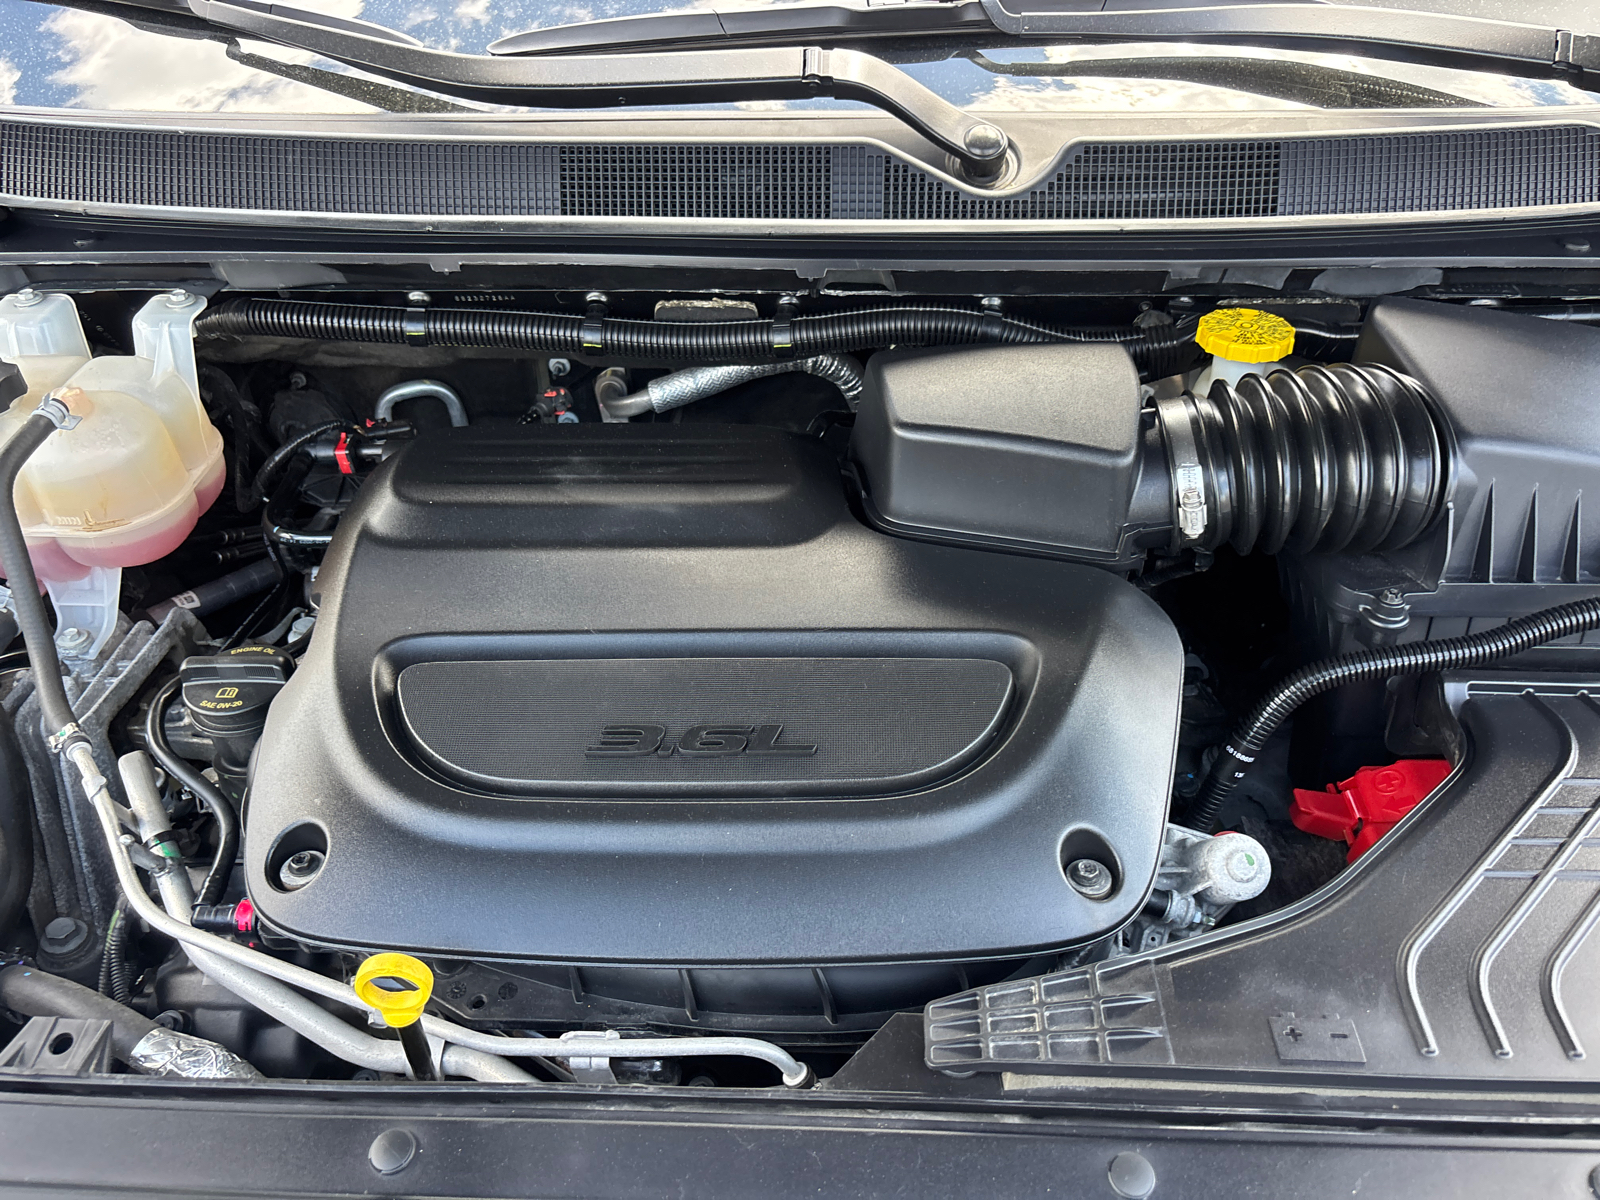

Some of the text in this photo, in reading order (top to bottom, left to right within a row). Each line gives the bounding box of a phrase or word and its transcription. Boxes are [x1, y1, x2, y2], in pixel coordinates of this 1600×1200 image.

[230, 646, 276, 656] ENGINE OIL
[199, 700, 243, 709] SAE 0W-20
[585, 723, 819, 757] 3.6L
